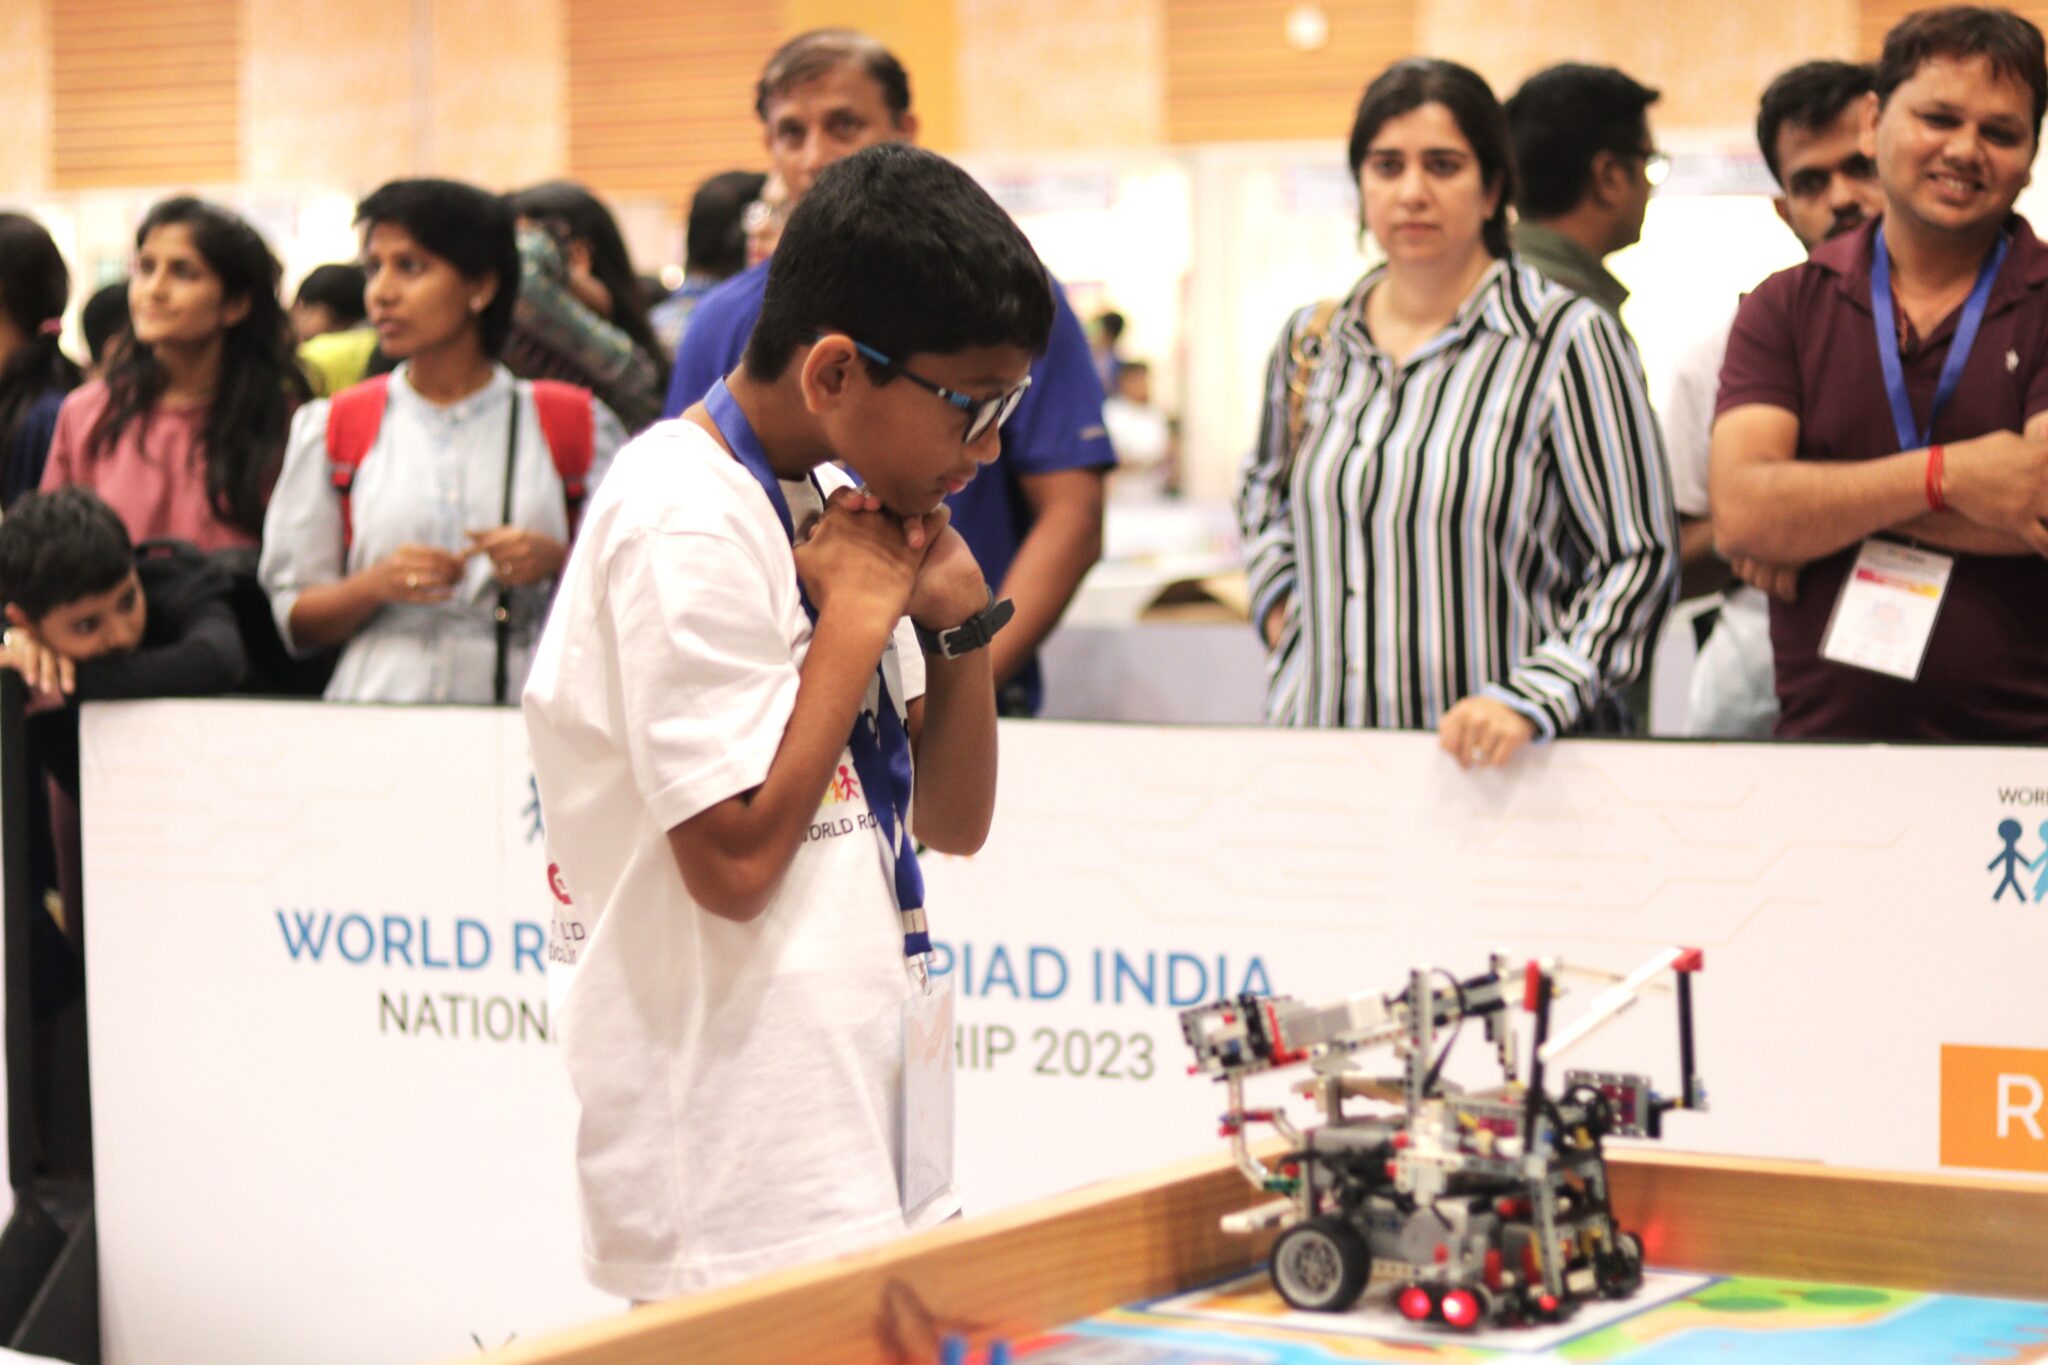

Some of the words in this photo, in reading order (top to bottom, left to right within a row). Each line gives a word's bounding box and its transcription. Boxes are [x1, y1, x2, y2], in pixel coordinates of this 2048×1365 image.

[804, 817, 854, 842] ORLD
[857, 812, 878, 829] RO
[1997, 786, 2048, 806] WOR
[276, 909, 493, 971] WORLD
[513, 921, 546, 974] R
[925, 941, 1070, 1001] PIAD
[1093, 949, 1273, 1007] INDIA
[379, 991, 558, 1045] NATION
[1032, 1027, 1155, 1082] 2023
[1996, 1072, 2046, 1141] R
